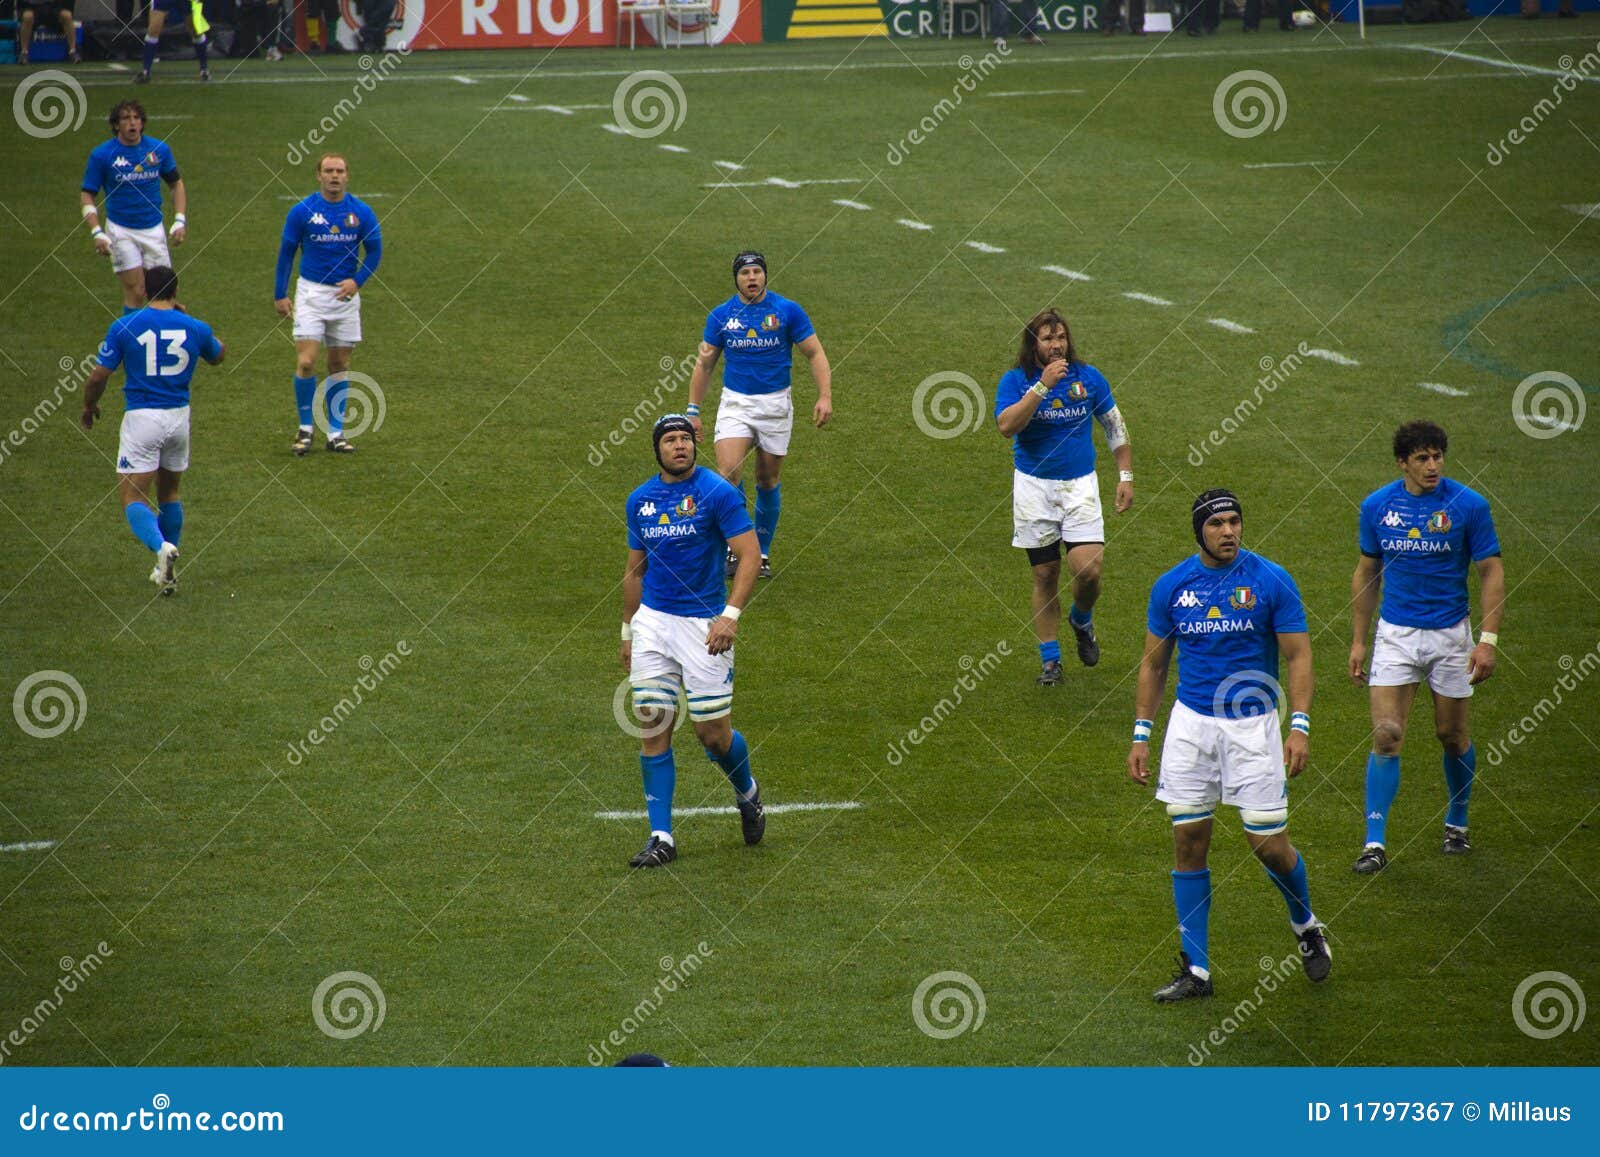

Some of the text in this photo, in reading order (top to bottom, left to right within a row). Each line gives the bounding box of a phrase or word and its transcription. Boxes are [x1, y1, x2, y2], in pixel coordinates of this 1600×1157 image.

[726, 336, 780, 348] CARIPARMA
[136, 328, 190, 377] 13
[1036, 405, 1087, 420] ARIPARMA
[1380, 539, 1452, 552] CARIPARMA
[1179, 618, 1254, 634] CARIPARMA
